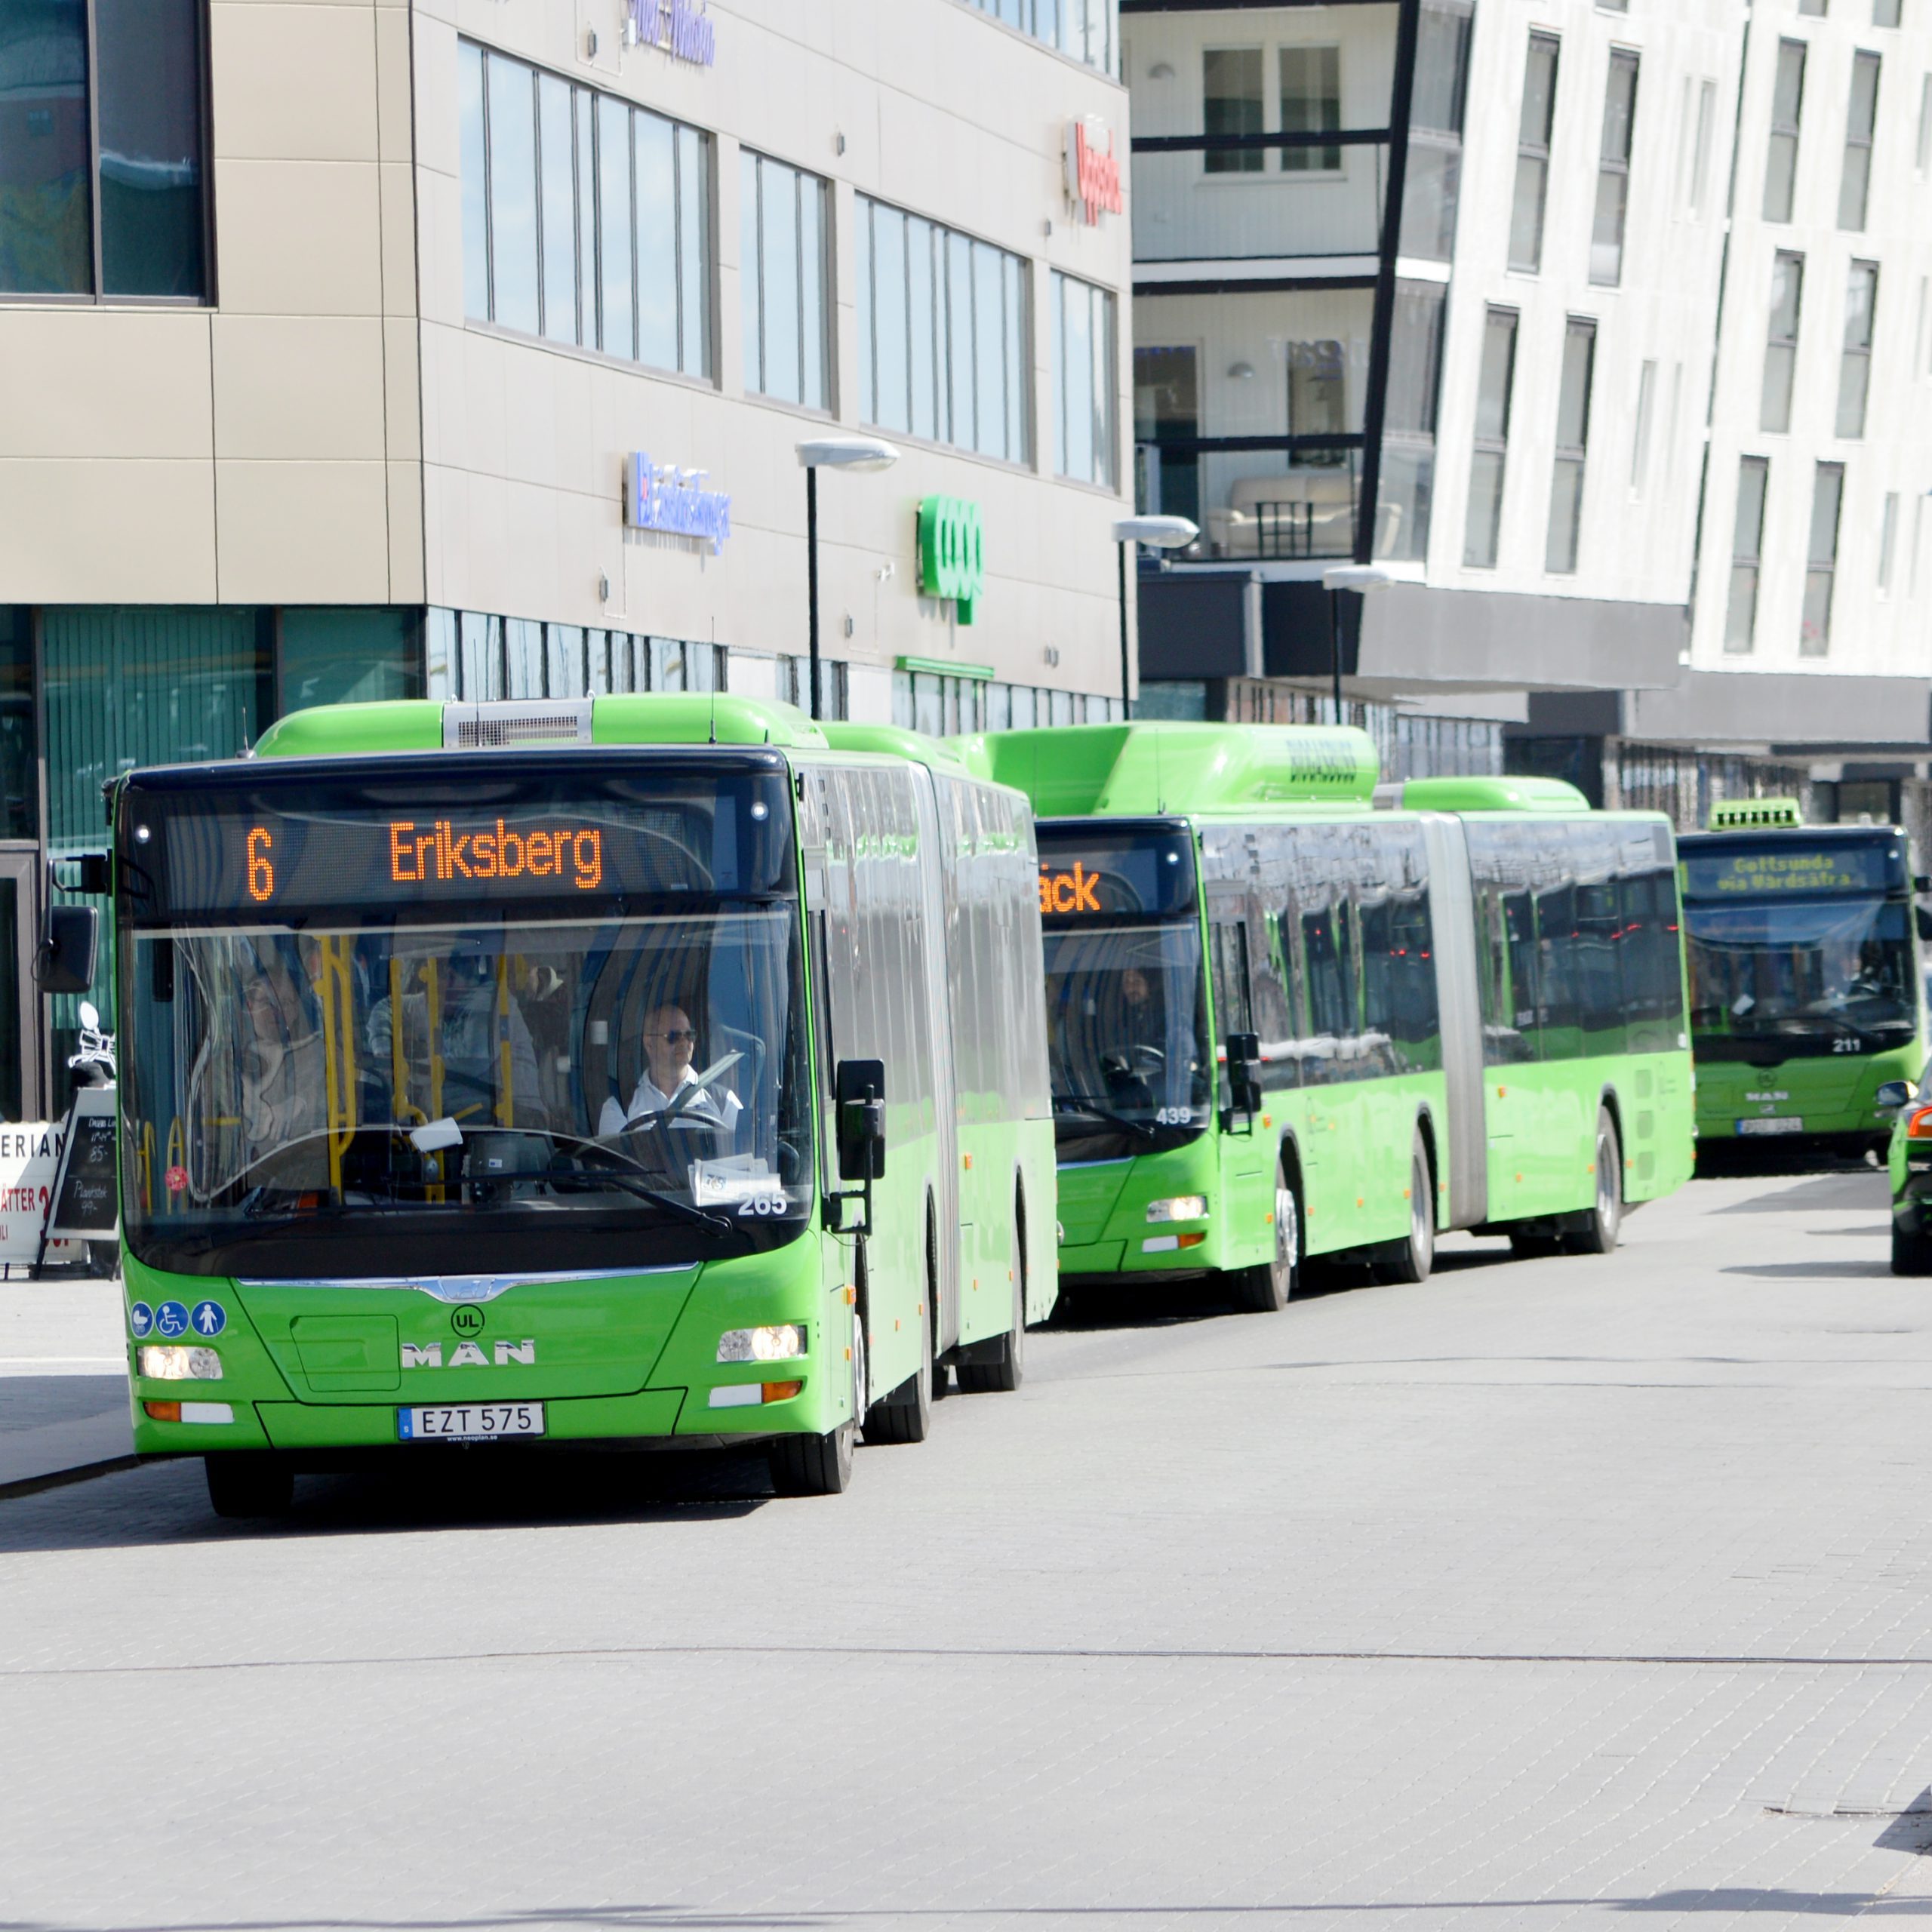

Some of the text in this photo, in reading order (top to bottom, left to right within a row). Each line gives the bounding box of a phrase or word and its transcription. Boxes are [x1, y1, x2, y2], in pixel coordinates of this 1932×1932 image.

[247, 819, 601, 902] 6 Eriksberg
[1832, 1038, 1861, 1052] 211
[1155, 1108, 1192, 1125] 439
[738, 1189, 787, 1216] 265
[456, 1314, 479, 1328] UL
[401, 1339, 535, 1368] MAN
[423, 1407, 531, 1433] EZT 575
[447, 1434, 498, 1442] www.neoplan.se
